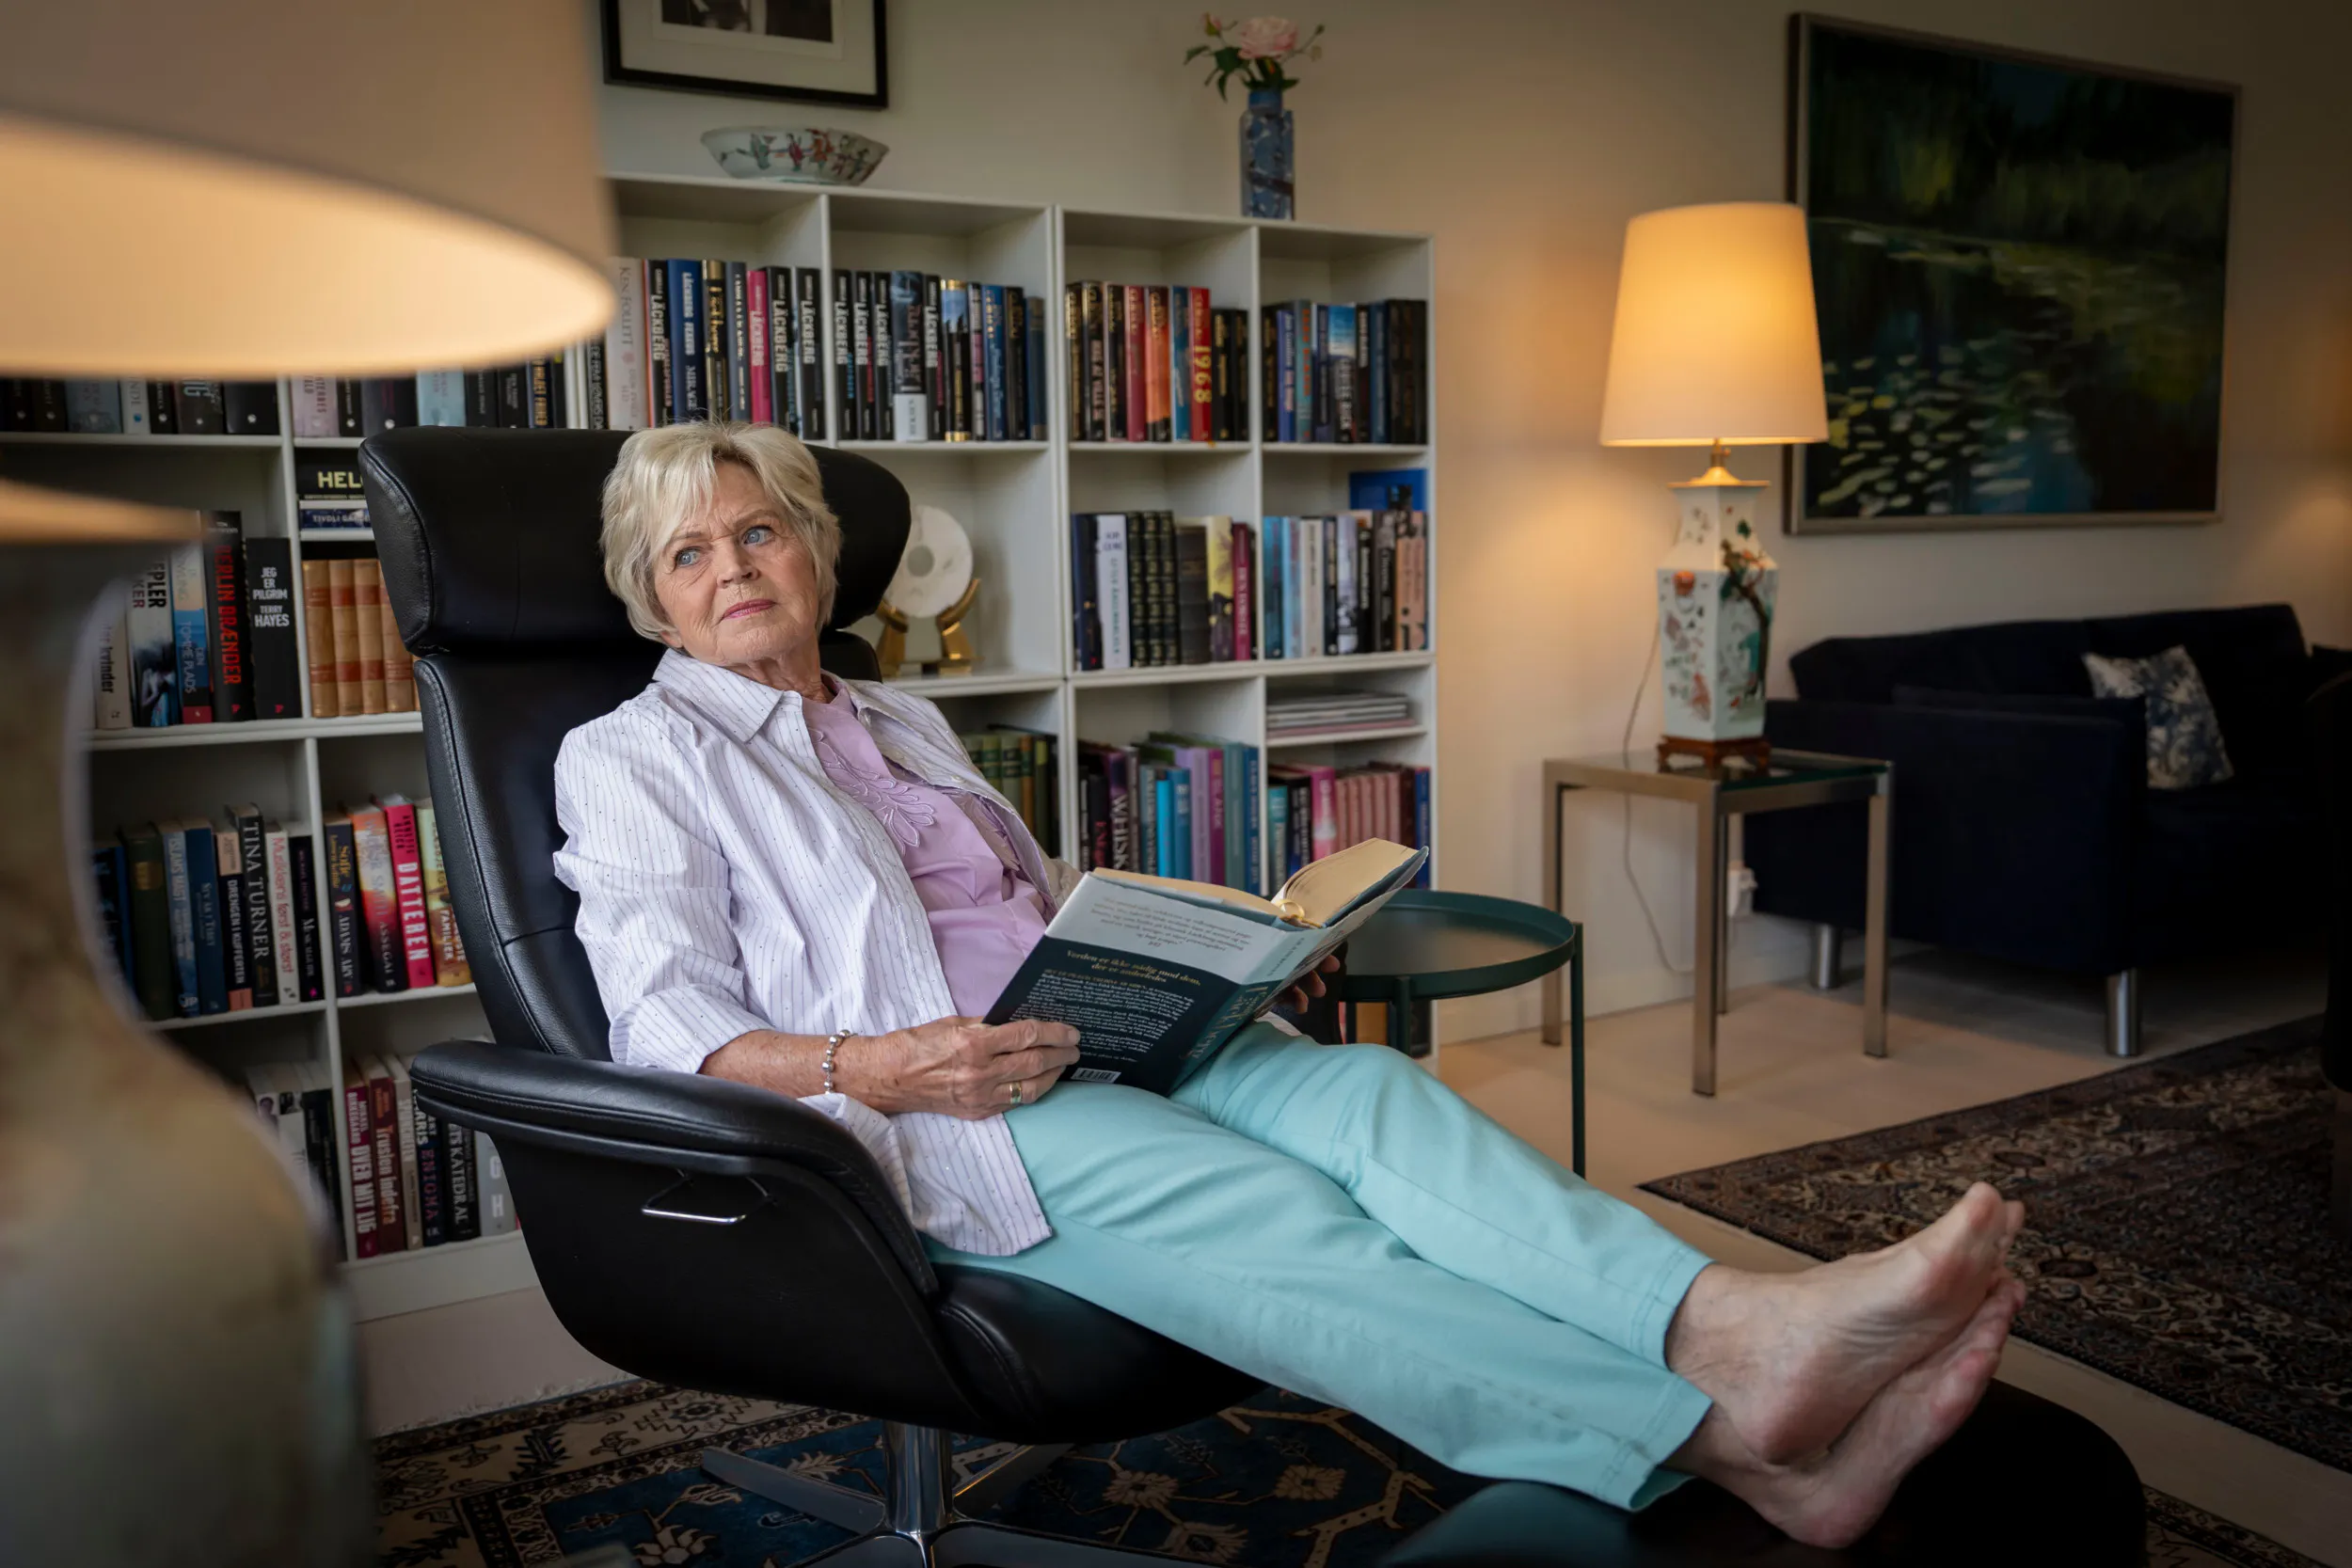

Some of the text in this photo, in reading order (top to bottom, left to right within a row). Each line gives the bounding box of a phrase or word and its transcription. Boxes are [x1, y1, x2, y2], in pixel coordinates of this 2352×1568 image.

[619, 267, 633, 347] KEN FOLLETT
[650, 294, 666, 361] LÄCKBERG
[772, 299, 788, 372] LÄCKBERG
[801, 300, 816, 364] LÄCKBERG
[834, 302, 849, 365] LÄCKBERG
[854, 302, 868, 365] LÄCKBERG
[875, 304, 889, 367] LÄCKBERG
[749, 310, 764, 366] LÄCKBERG
[925, 306, 938, 368] LÄCKBERG
[1194, 345, 1212, 404] 1968
[318, 471, 367, 489] HEL
[312, 515, 340, 523] TIVOLI
[147, 563, 167, 609] EPLER
[252, 589, 289, 600] PILGRIM
[260, 567, 278, 578] JEG
[263, 578, 276, 589] ER
[214, 546, 242, 685] BERLIN BRÆNDER
[254, 613, 290, 627] HAYES
[260, 606, 283, 614] TERRY
[101, 647, 115, 694] kvinder
[179, 621, 197, 694] TOMME PLADS
[195, 647, 205, 666] DEN
[1113, 795, 1131, 870] WHISK
[168, 838, 186, 901] ISLAMS MAGT
[242, 821, 270, 959] TINA TURNER
[371, 875, 388, 916] SMITH
[227, 879, 241, 926] DRENGEN
[271, 837, 294, 974] Musikkens først & størst
[397, 862, 430, 961] DATTEREN
[231, 932, 246, 985] KUFFERTEN
[338, 914, 353, 979] ADAMS ARV
[379, 921, 394, 974] ASSEGAI
[440, 910, 453, 960] FAMILIER
[1067, 949, 1098, 962] Verden
[1110, 958, 1130, 967] ikke
[1159, 970, 1180, 979] mod
[1120, 969, 1167, 983] anderledes
[375, 1124, 394, 1175] Truslen
[350, 1144, 377, 1233] OVER MIT LIG
[379, 1177, 399, 1225] indefra
[421, 1148, 438, 1221] ENIGMA
[449, 1146, 469, 1225] KATEDRAL
